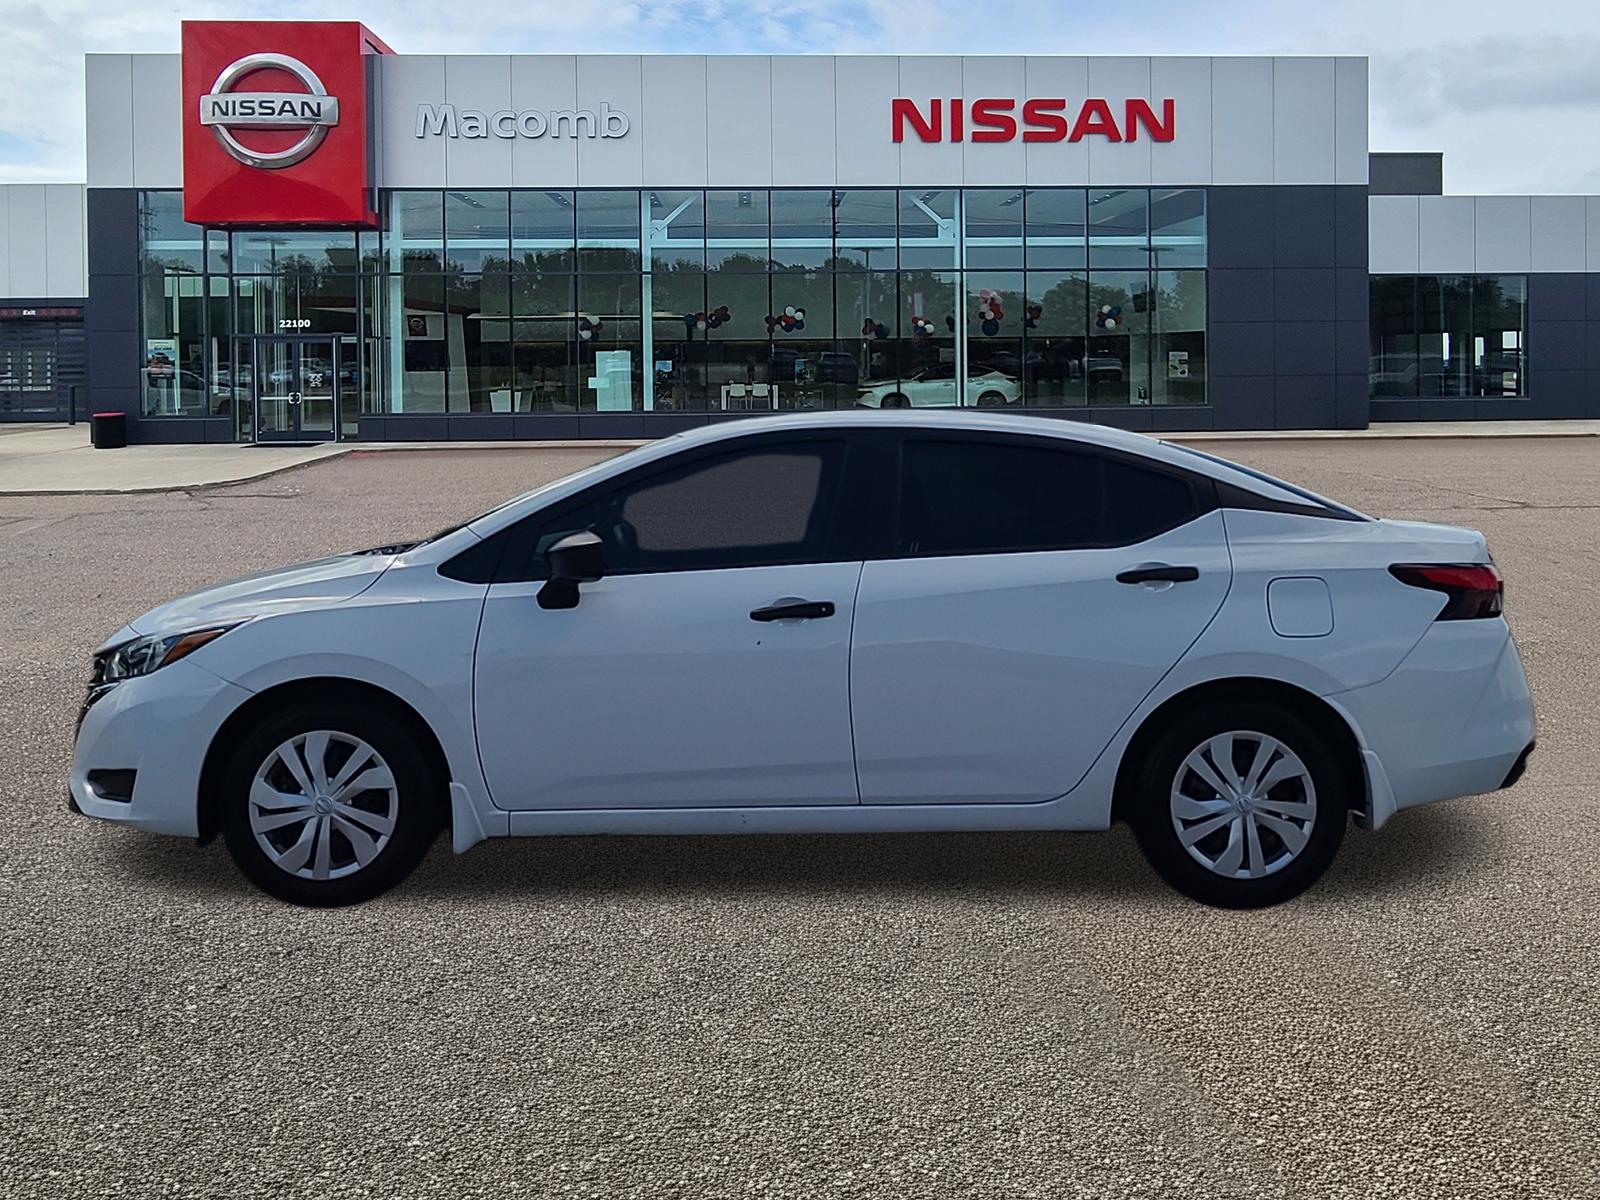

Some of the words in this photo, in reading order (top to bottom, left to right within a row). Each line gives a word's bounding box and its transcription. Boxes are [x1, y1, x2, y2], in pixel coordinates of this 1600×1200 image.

[212, 100, 322, 118] NISSAN
[415, 102, 630, 139] Macomb
[892, 98, 1175, 143] NISSAN
[279, 319, 311, 328] 22100
